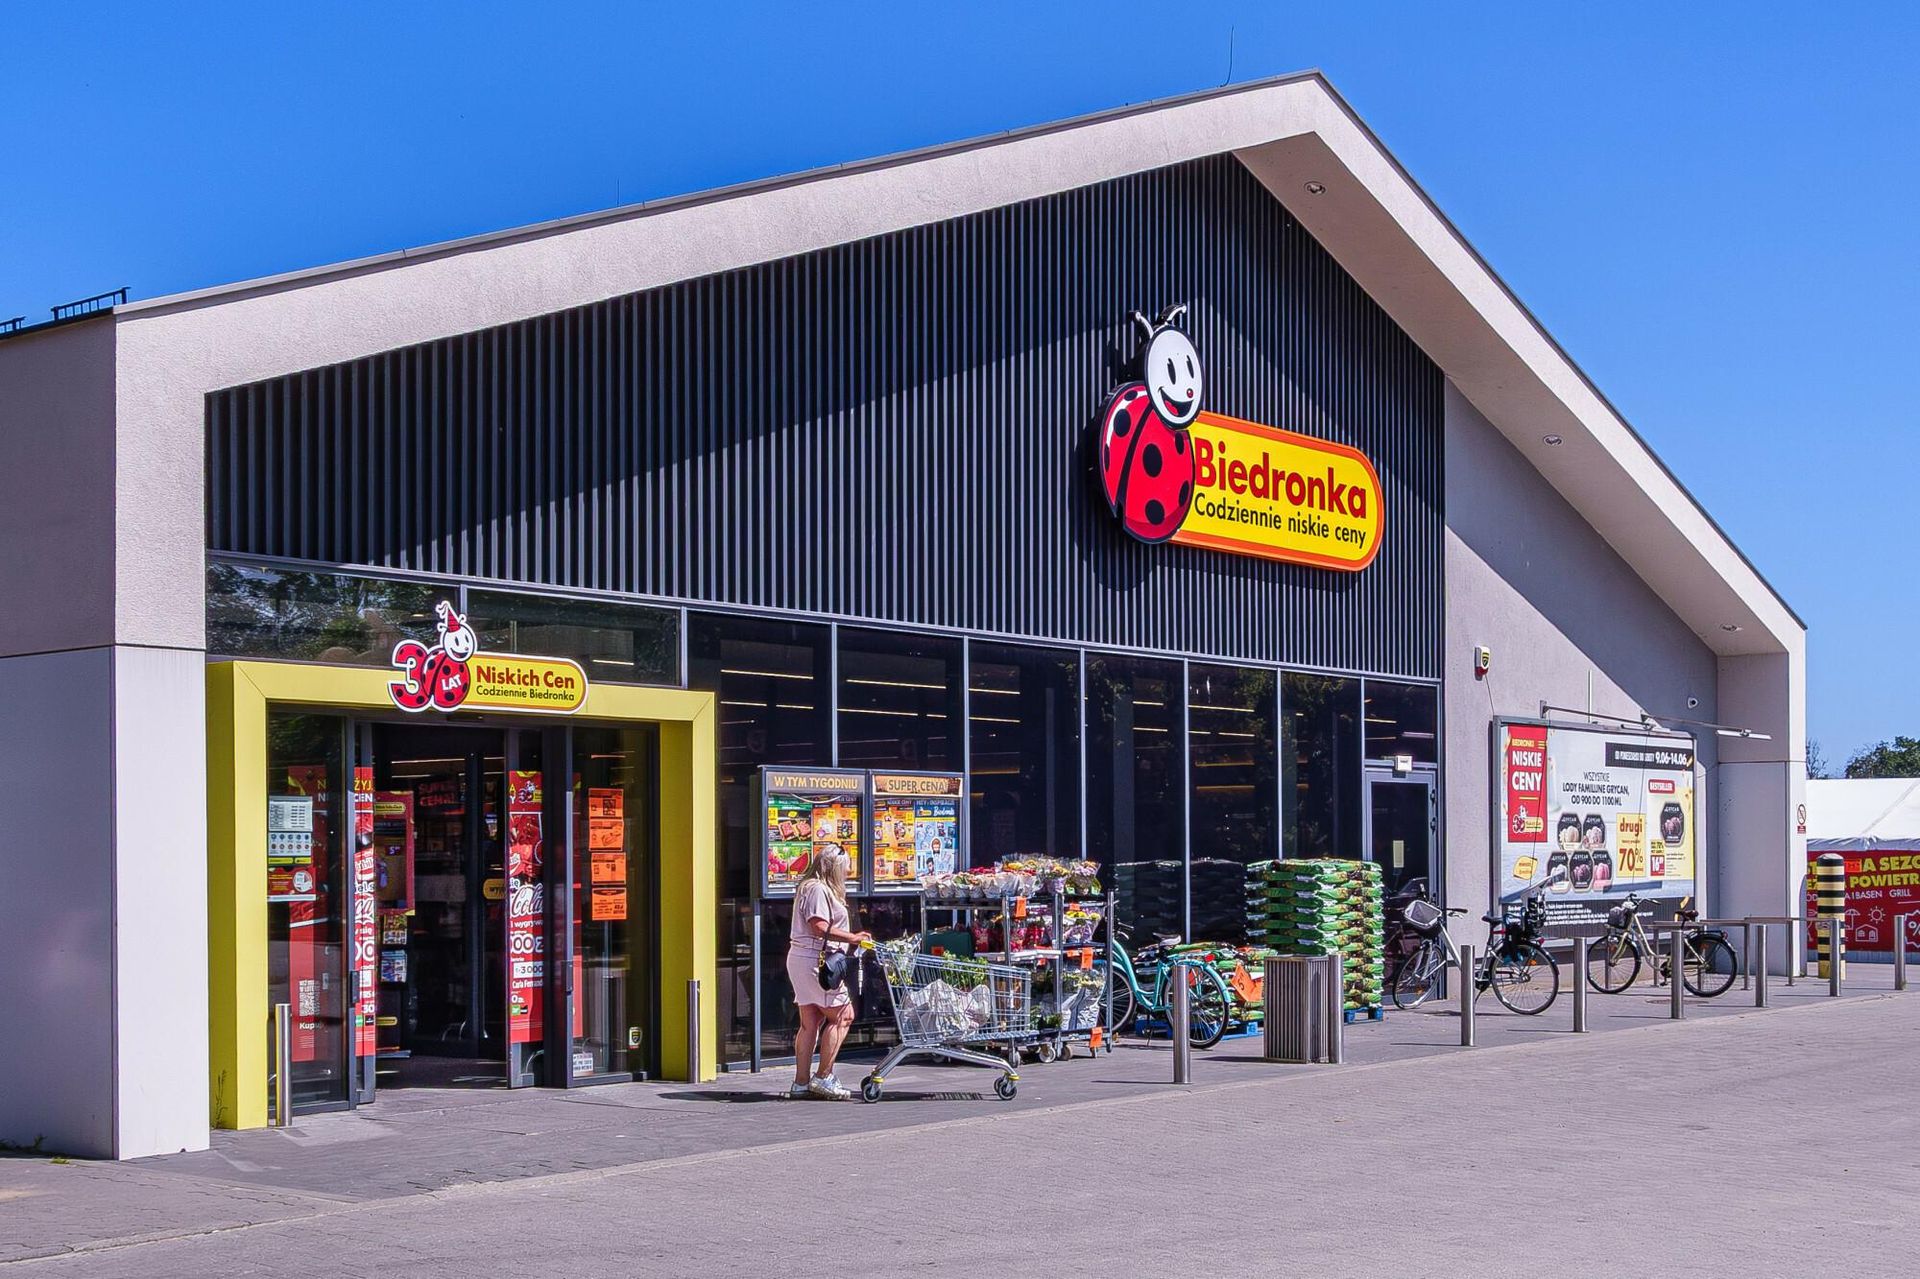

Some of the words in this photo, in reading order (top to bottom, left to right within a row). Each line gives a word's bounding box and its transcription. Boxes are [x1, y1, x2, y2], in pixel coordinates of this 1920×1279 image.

[1195, 437, 1366, 519] Biedronka
[1195, 493, 1282, 530] Codziennie
[1288, 512, 1330, 539] niskie
[1335, 526, 1367, 549] ceny
[441, 674, 462, 691] LAT
[476, 665, 540, 687] Niskich
[543, 671, 575, 689] Cen
[476, 685, 528, 698] Codziennie
[529, 688, 575, 701] Biedronka
[1512, 750, 1543, 767] NISKIE
[1655, 751, 1687, 766] 9.06-14.06
[774, 775, 786, 787] W
[787, 776, 807, 788] TYM
[809, 777, 858, 789] TYGODNIU
[888, 779, 917, 791] SUPER
[1512, 771, 1543, 791] CENY
[1562, 782, 1578, 792] LODY
[1581, 795, 1592, 805] 900
[1592, 796, 1601, 805] DO
[1619, 817, 1643, 837] drugi
[1619, 847, 1644, 872] 70%
[1855, 890, 1883, 899] BASEN
[1889, 888, 1912, 898] GRILL
